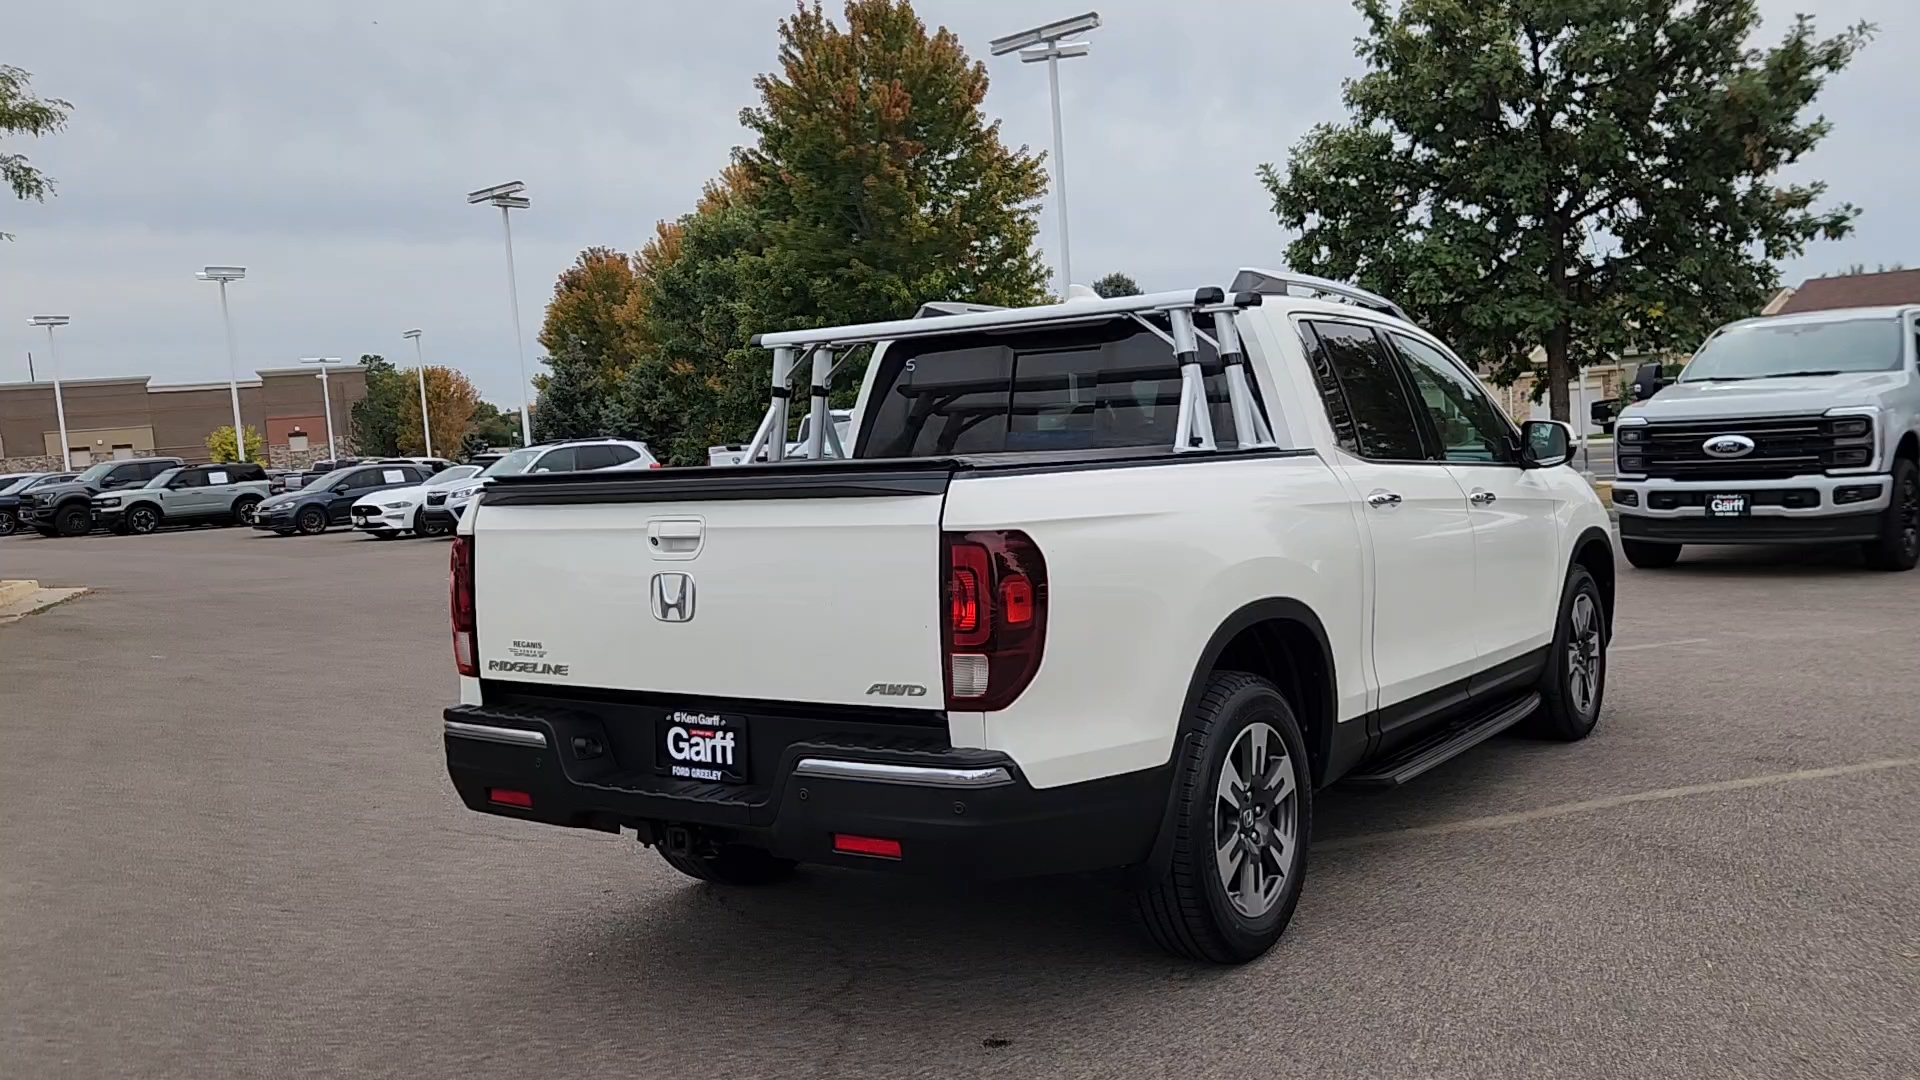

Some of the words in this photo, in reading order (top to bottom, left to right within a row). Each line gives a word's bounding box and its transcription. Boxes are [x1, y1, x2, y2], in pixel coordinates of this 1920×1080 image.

[1711, 499, 1744, 511] Garff
[488, 660, 569, 676] RIDGELINE
[865, 683, 927, 697] AWD
[680, 712, 698, 724] Ken
[698, 714, 721, 726] Garff
[667, 726, 735, 765] Garff
[672, 765, 690, 777] FORD
[691, 768, 722, 780] GREELEY
